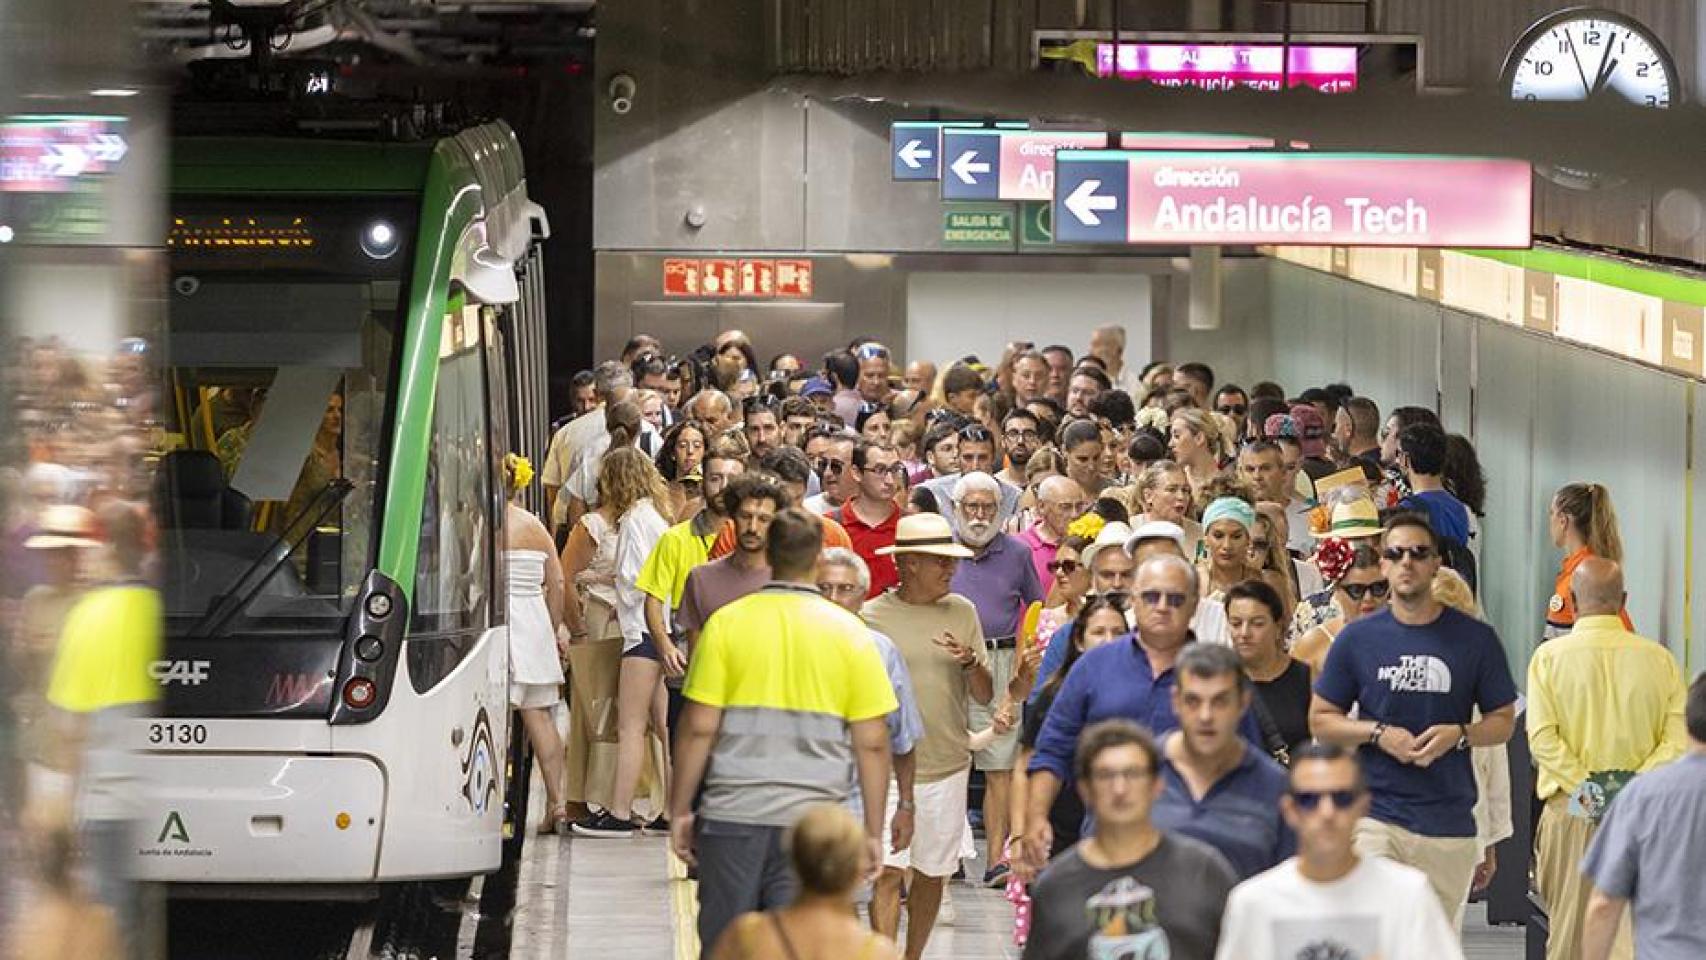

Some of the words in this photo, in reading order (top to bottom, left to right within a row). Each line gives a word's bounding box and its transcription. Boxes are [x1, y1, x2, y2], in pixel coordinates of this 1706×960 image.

[1583, 31, 1601, 45] 12
[1558, 40, 1569, 54] 11
[1620, 41, 1626, 54] 1
[1534, 61, 1553, 75] 10
[1636, 62, 1649, 77] 2
[1154, 166, 1240, 188] dirección
[1153, 194, 1334, 234] Andalucía
[1344, 197, 1428, 235] Tech
[1400, 655, 1428, 668] THE
[147, 659, 210, 686] CAF
[1377, 666, 1427, 680] NORTH
[1389, 680, 1428, 692] FACE
[149, 723, 207, 744] 3130
